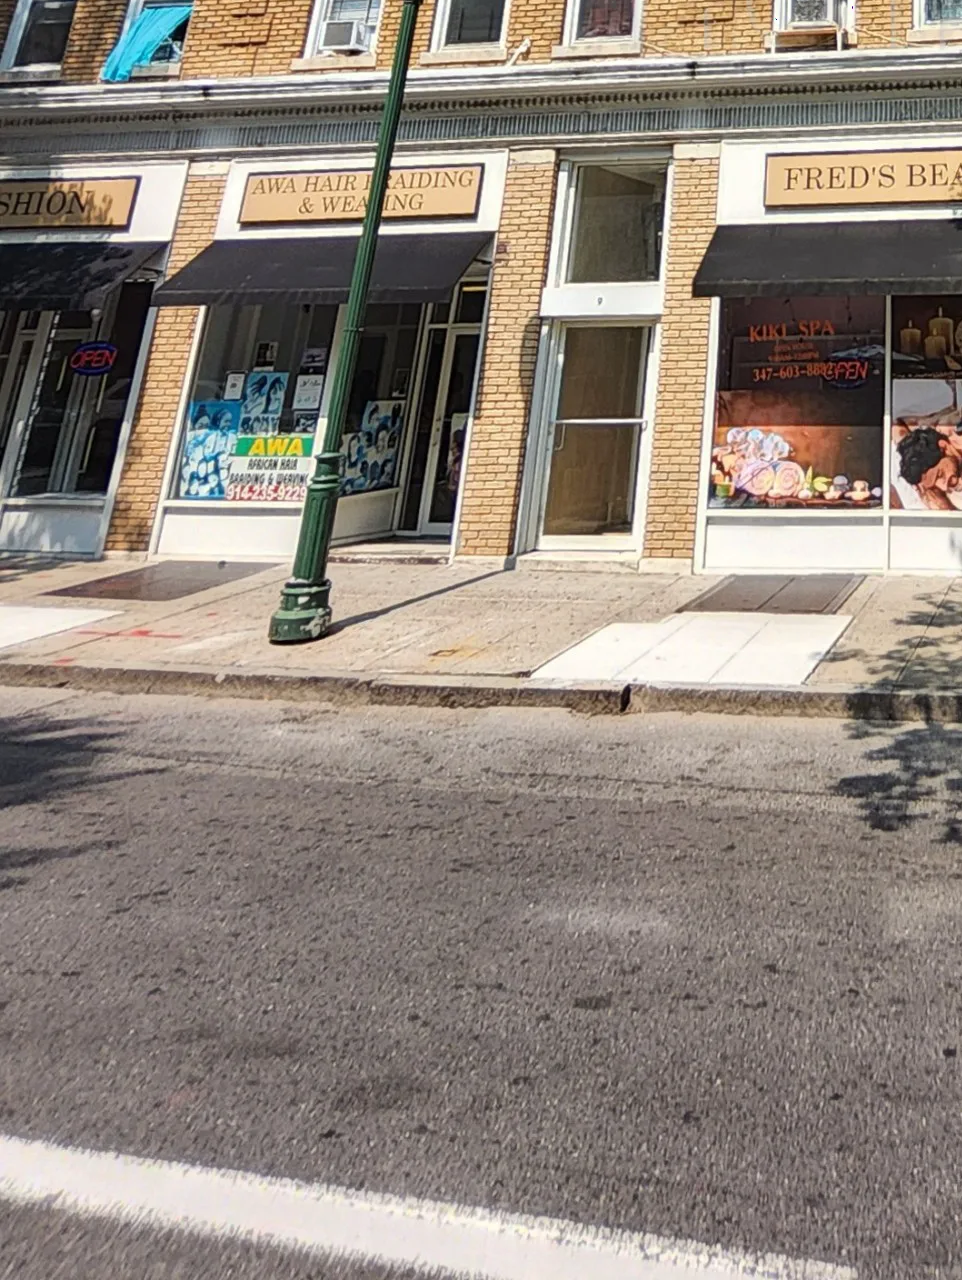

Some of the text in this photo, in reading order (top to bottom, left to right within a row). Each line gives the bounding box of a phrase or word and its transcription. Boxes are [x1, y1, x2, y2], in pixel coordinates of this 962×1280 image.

[251, 177, 297, 195] AWA
[302, 174, 362, 194] HAIR
[783, 164, 896, 191] FRED'S
[298, 192, 425, 215] & WEAING
[749, 319, 836, 343] KIKI SPA
[70, 348, 118, 369] OPEN
[823, 361, 869, 380] OPEN
[247, 436, 304, 457] AWA
[247, 458, 299, 471] AFRICAN HAIR
[226, 482, 308, 501] 914-235-9229
